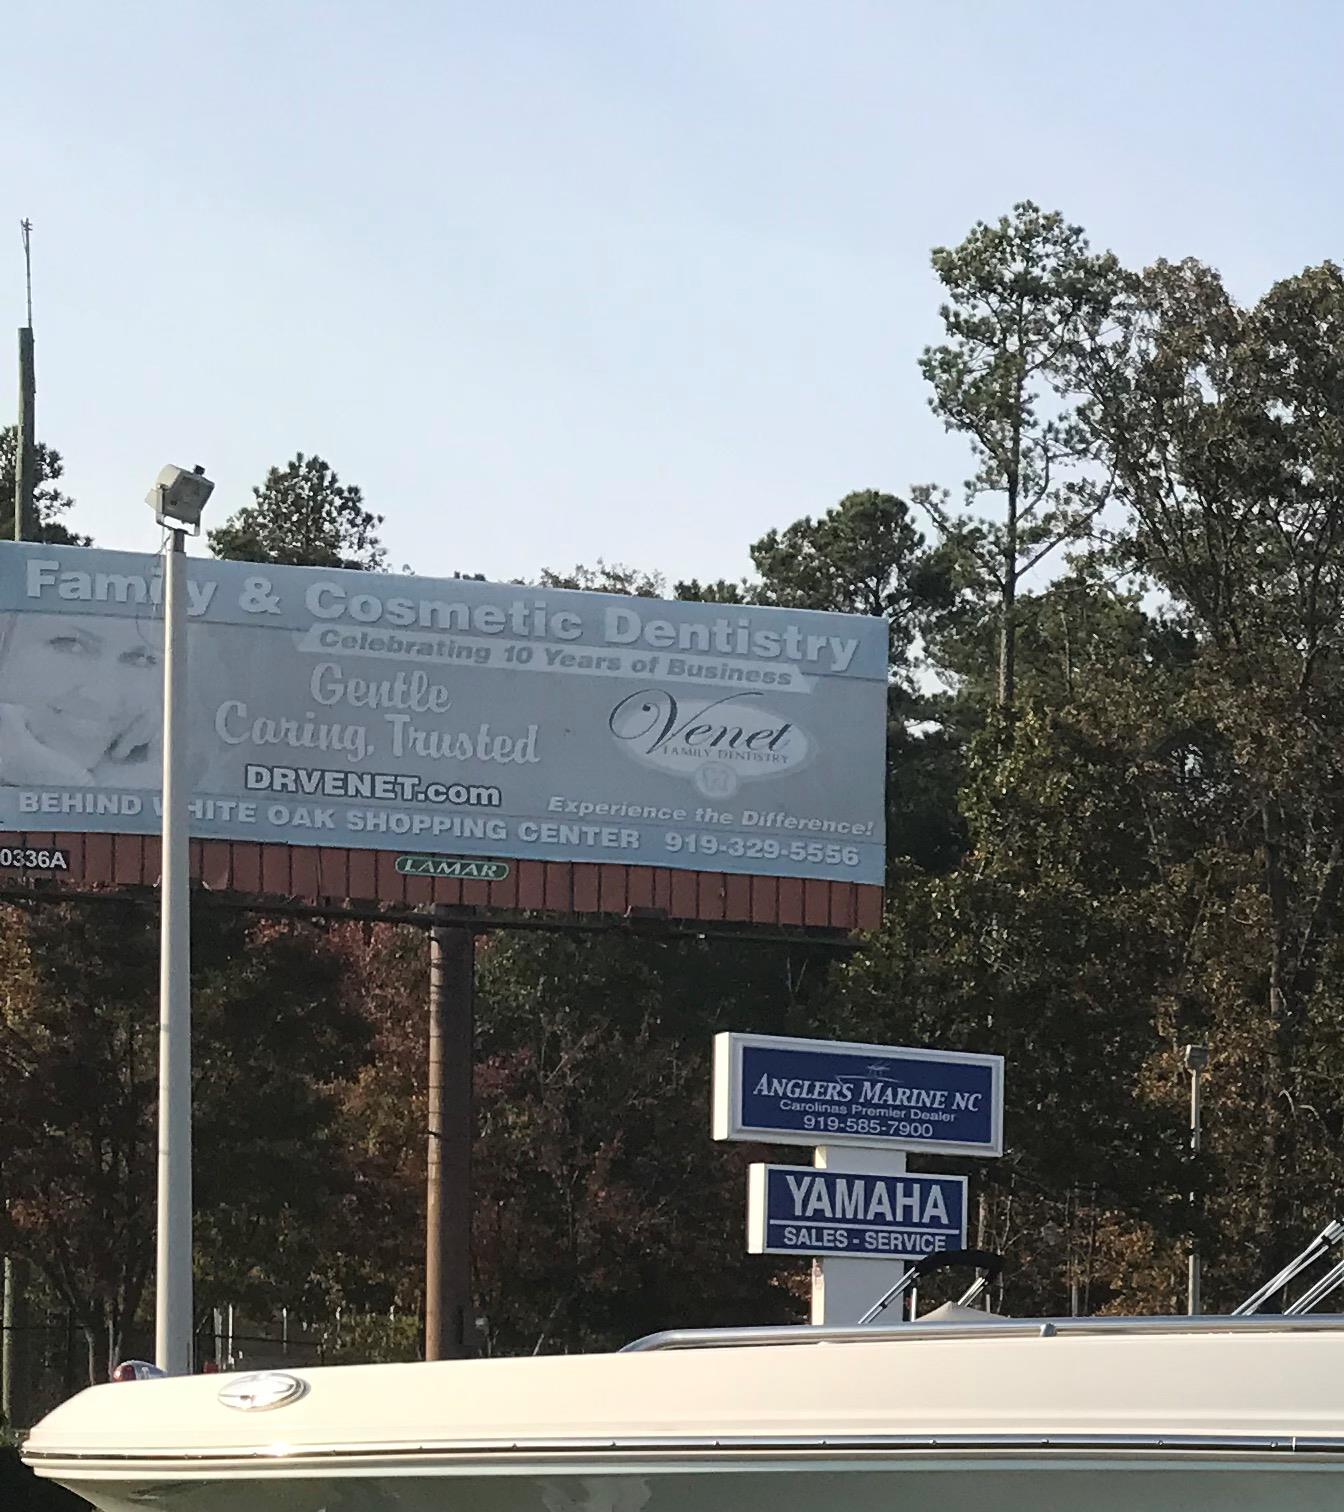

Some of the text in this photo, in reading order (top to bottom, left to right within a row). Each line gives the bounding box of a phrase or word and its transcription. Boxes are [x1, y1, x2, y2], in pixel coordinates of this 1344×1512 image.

[26, 559, 860, 672] Famiy & Cosmetic Dentistry
[320, 629, 792, 686] Celebrating 10 Years of Business
[310, 662, 451, 713] Gentle
[384, 713, 541, 764] Trusted
[609, 688, 793, 755] Venet
[663, 746, 789, 764] FAMILY DENTISTRY
[245, 764, 501, 806] DRVENET.com
[19, 792, 142, 815] BEHIND
[267, 805, 336, 829] OAK
[346, 809, 507, 840] SHOPPING
[518, 822, 640, 848] CENTER
[664, 832, 859, 866] 919-329-5556
[548, 797, 875, 836] Experience the Difference!
[404, 858, 498, 878] LAMAR
[753, 1073, 982, 1112] ANGLERS MARINE NC
[780, 1100, 956, 1122] Carolinas Premier Dealer
[803, 1115, 933, 1137] 919-585-7900
[785, 1175, 949, 1225] YAMAHA
[784, 1226, 849, 1248] SALES
[864, 1231, 946, 1252] SERVICE
